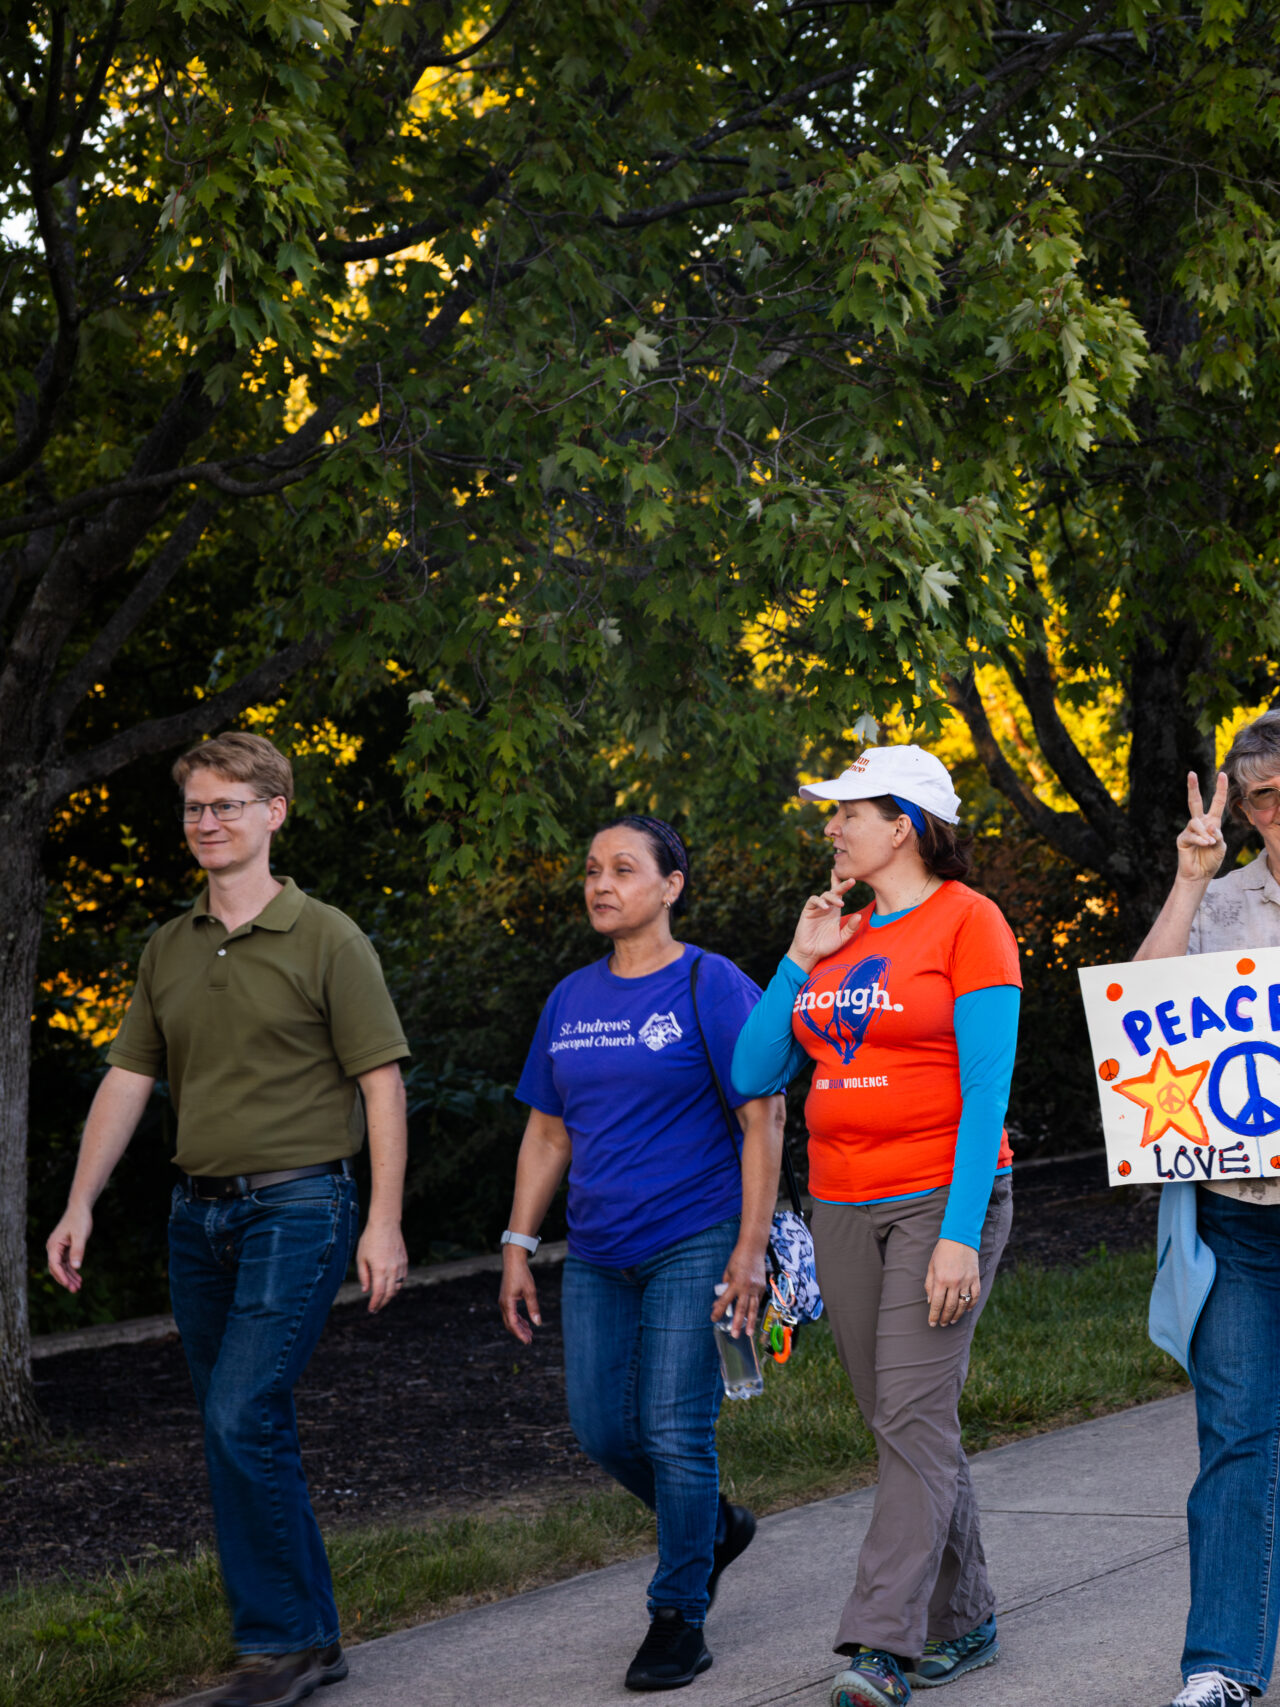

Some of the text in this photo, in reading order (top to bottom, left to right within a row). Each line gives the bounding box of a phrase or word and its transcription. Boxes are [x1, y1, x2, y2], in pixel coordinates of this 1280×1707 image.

[793, 982, 904, 1015] enough.
[560, 1018, 631, 1037] St. Andrews
[594, 1034, 636, 1048] Church
[1154, 1141, 1250, 1179] LOVE
